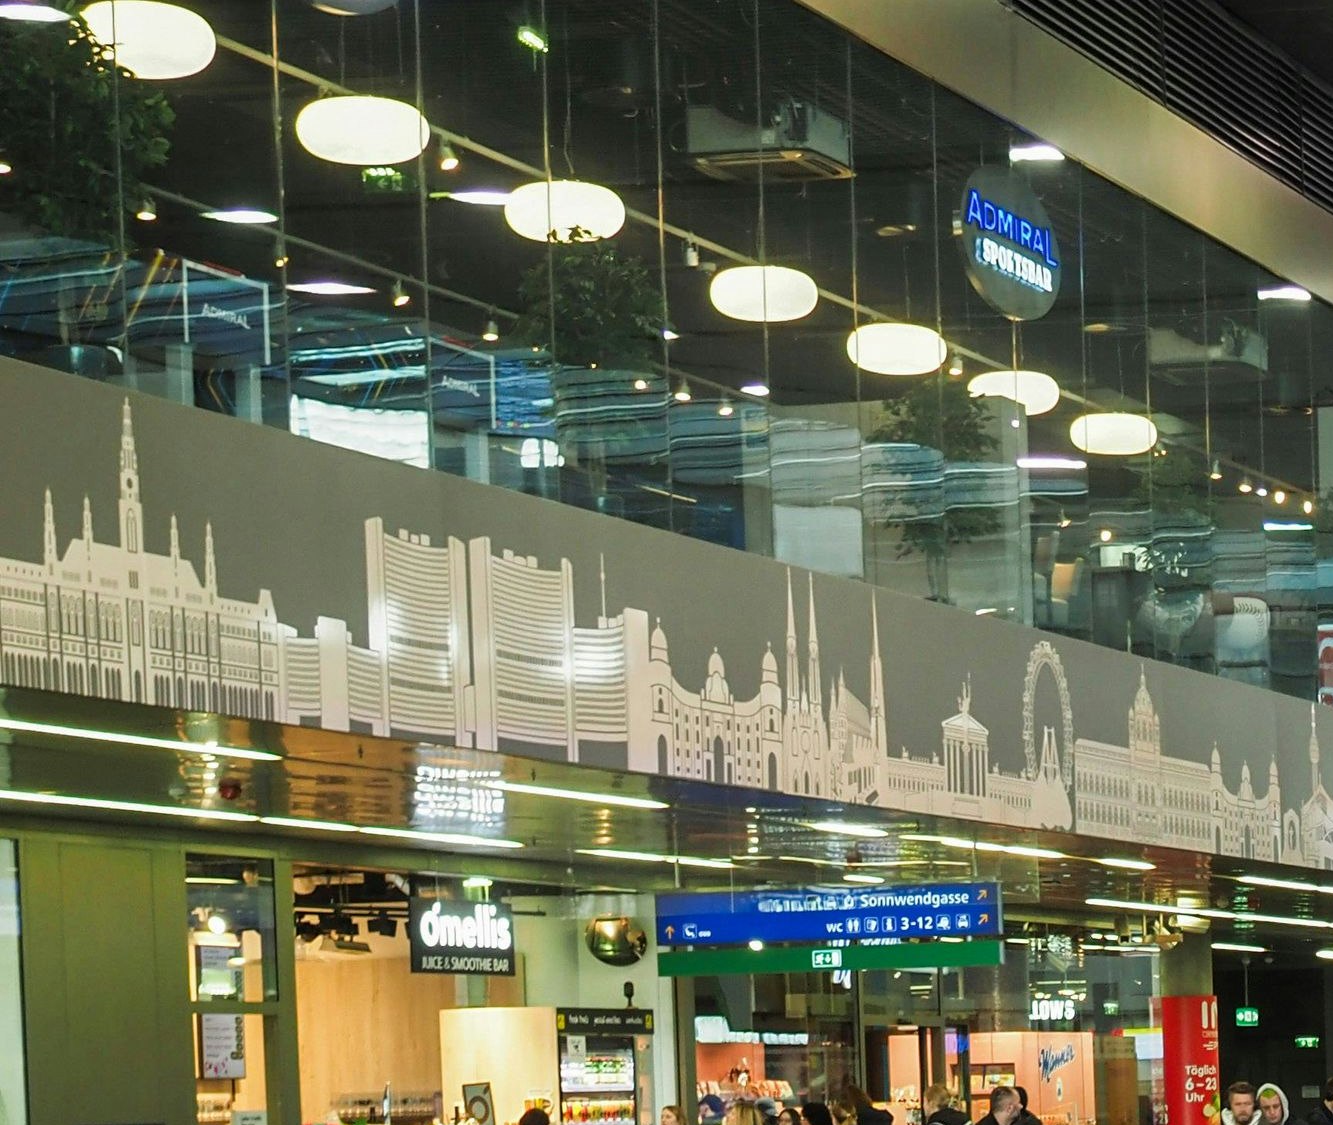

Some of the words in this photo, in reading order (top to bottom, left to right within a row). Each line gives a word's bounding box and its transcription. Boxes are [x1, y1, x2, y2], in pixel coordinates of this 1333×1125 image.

[967, 190, 1058, 267] ADMIRAL
[982, 237, 1053, 293] SPORTSBAR
[860, 891, 970, 908] Sonnwendgasse
[826, 922, 843, 933] WC
[422, 956, 443, 970] JUICE
[451, 957, 493, 971] SMOOTHIE
[493, 958, 510, 972] BAR
[1185, 1065, 1217, 1077] Täglich
[1185, 1093, 1205, 1103] Uhr
